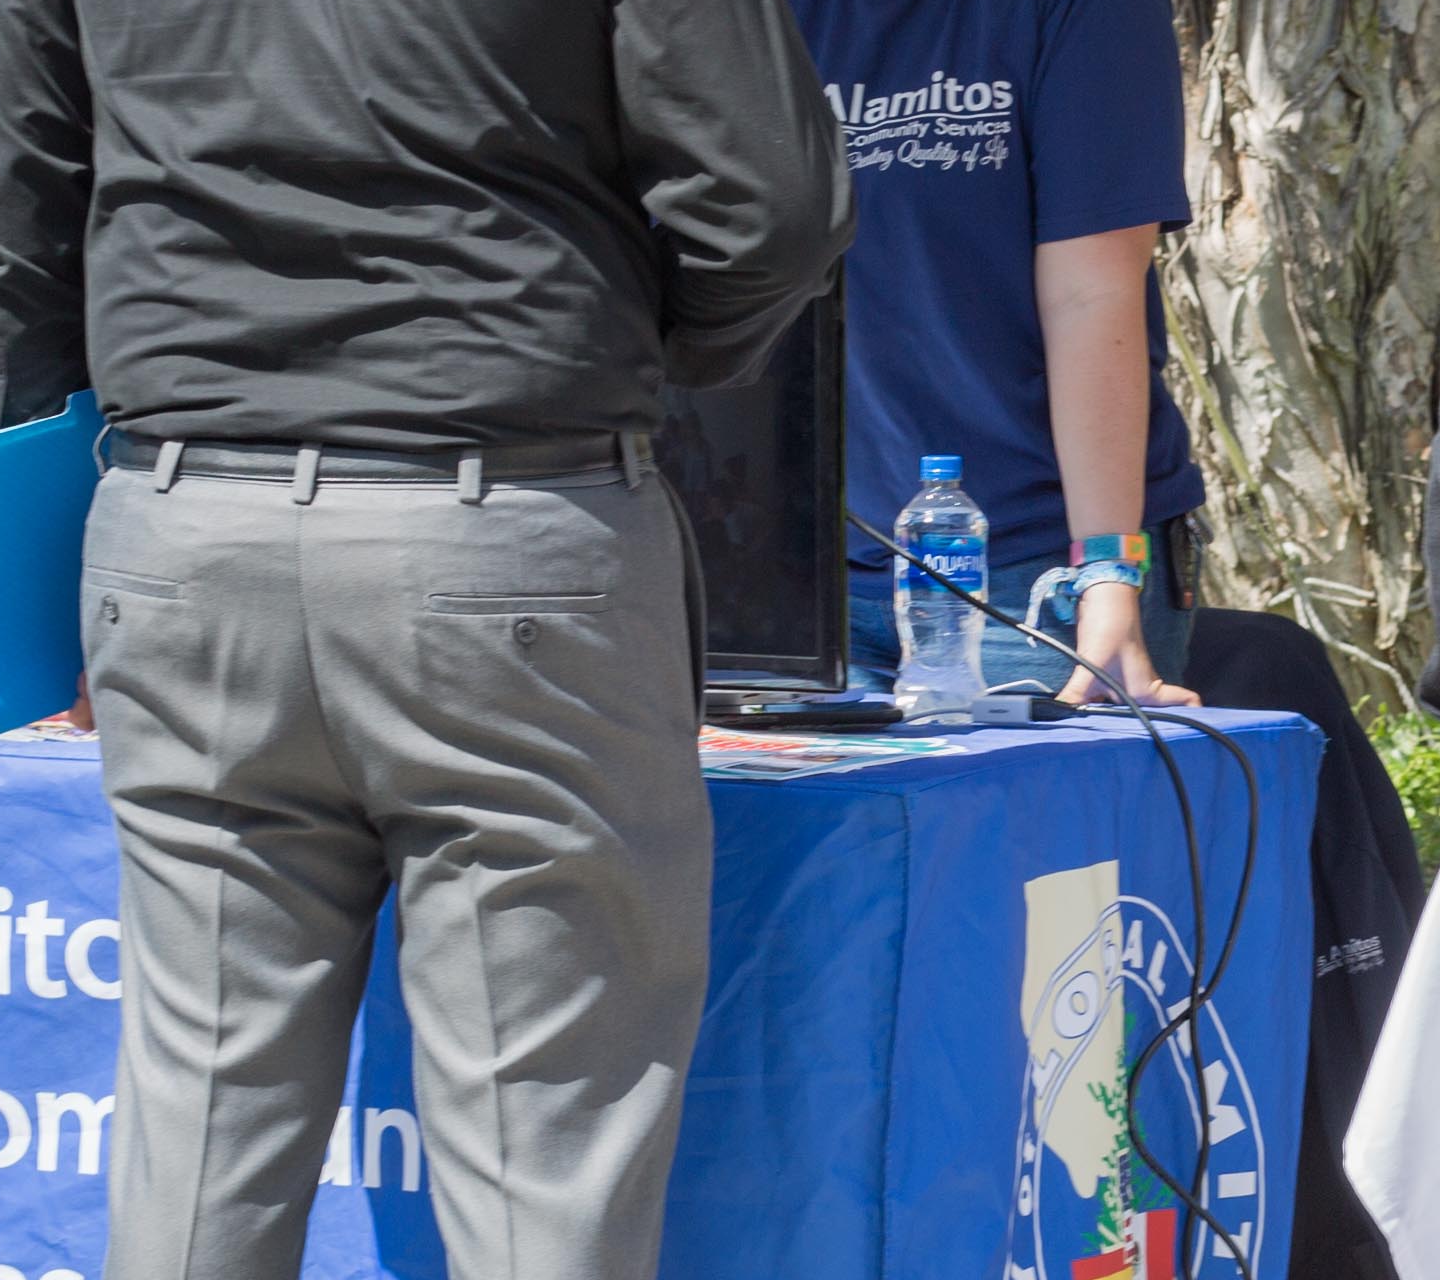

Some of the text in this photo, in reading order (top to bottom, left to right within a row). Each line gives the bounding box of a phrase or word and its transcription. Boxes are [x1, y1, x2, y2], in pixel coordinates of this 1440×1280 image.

[934, 117, 1012, 137] Services
[897, 139, 960, 170] Quality
[962, 142, 981, 172] of
